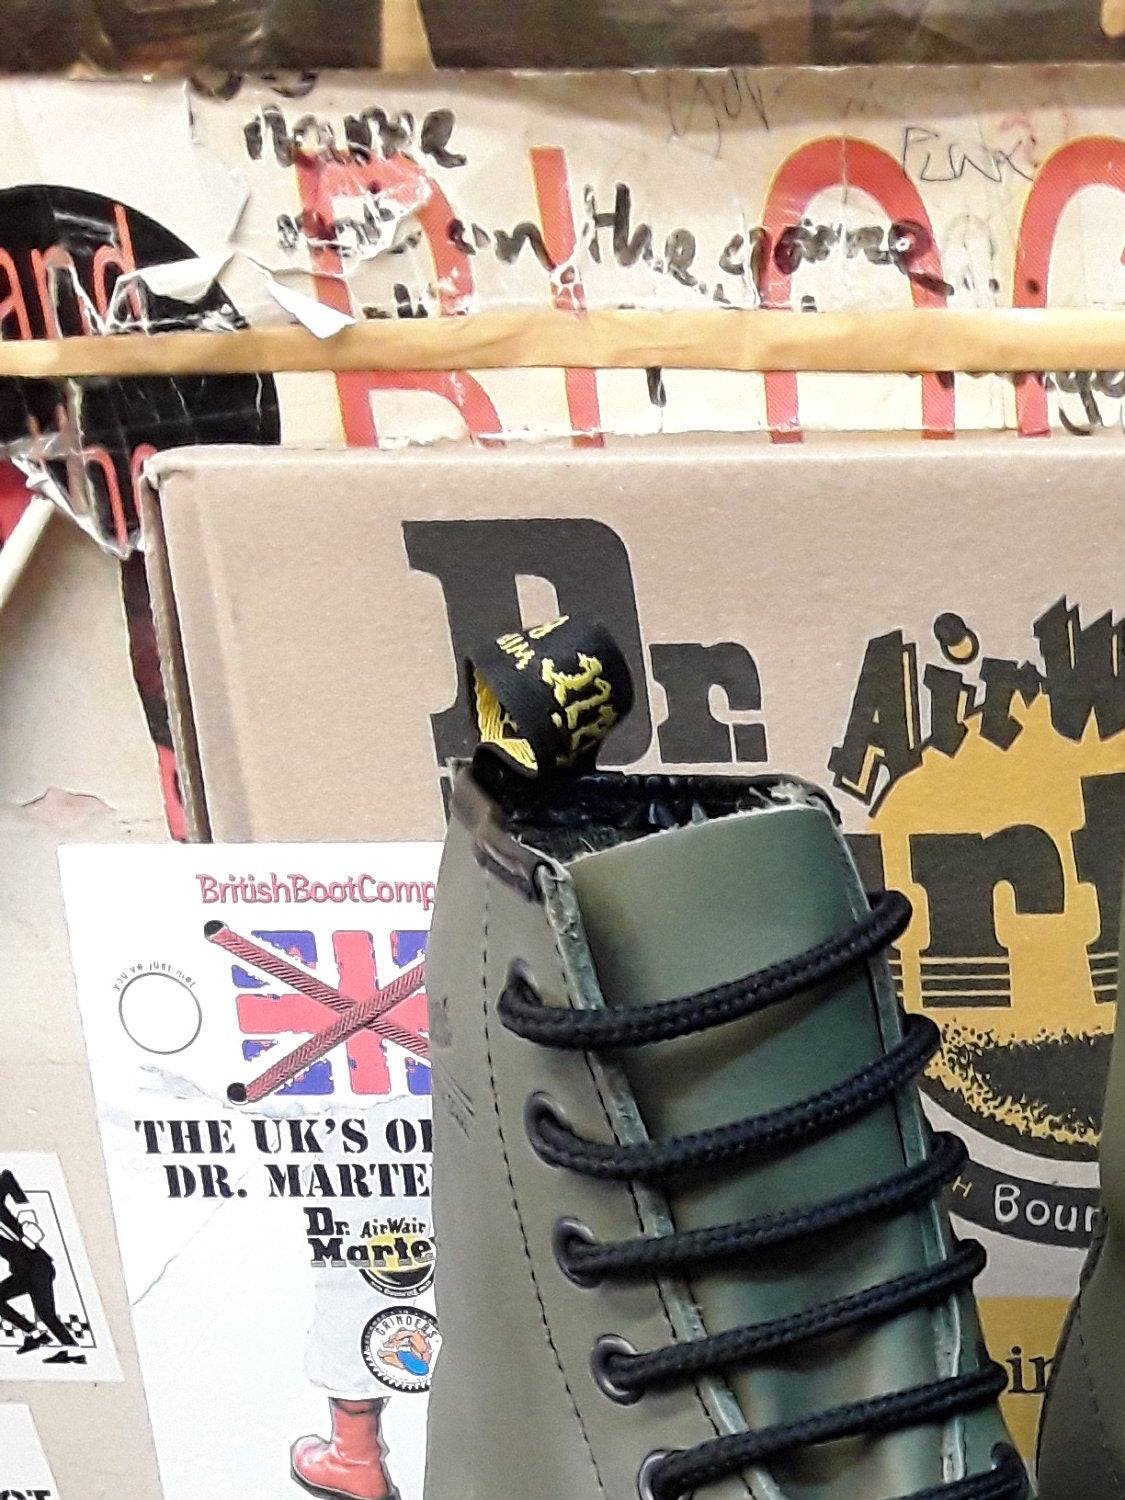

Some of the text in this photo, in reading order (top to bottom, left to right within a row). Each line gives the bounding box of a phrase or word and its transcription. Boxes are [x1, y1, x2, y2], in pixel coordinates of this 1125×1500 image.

[134, 1119, 235, 1154] THE
[251, 1118, 369, 1154] UK'S
[163, 1163, 433, 1199] DR. MARTE
[308, 1237, 437, 1268] Marte
